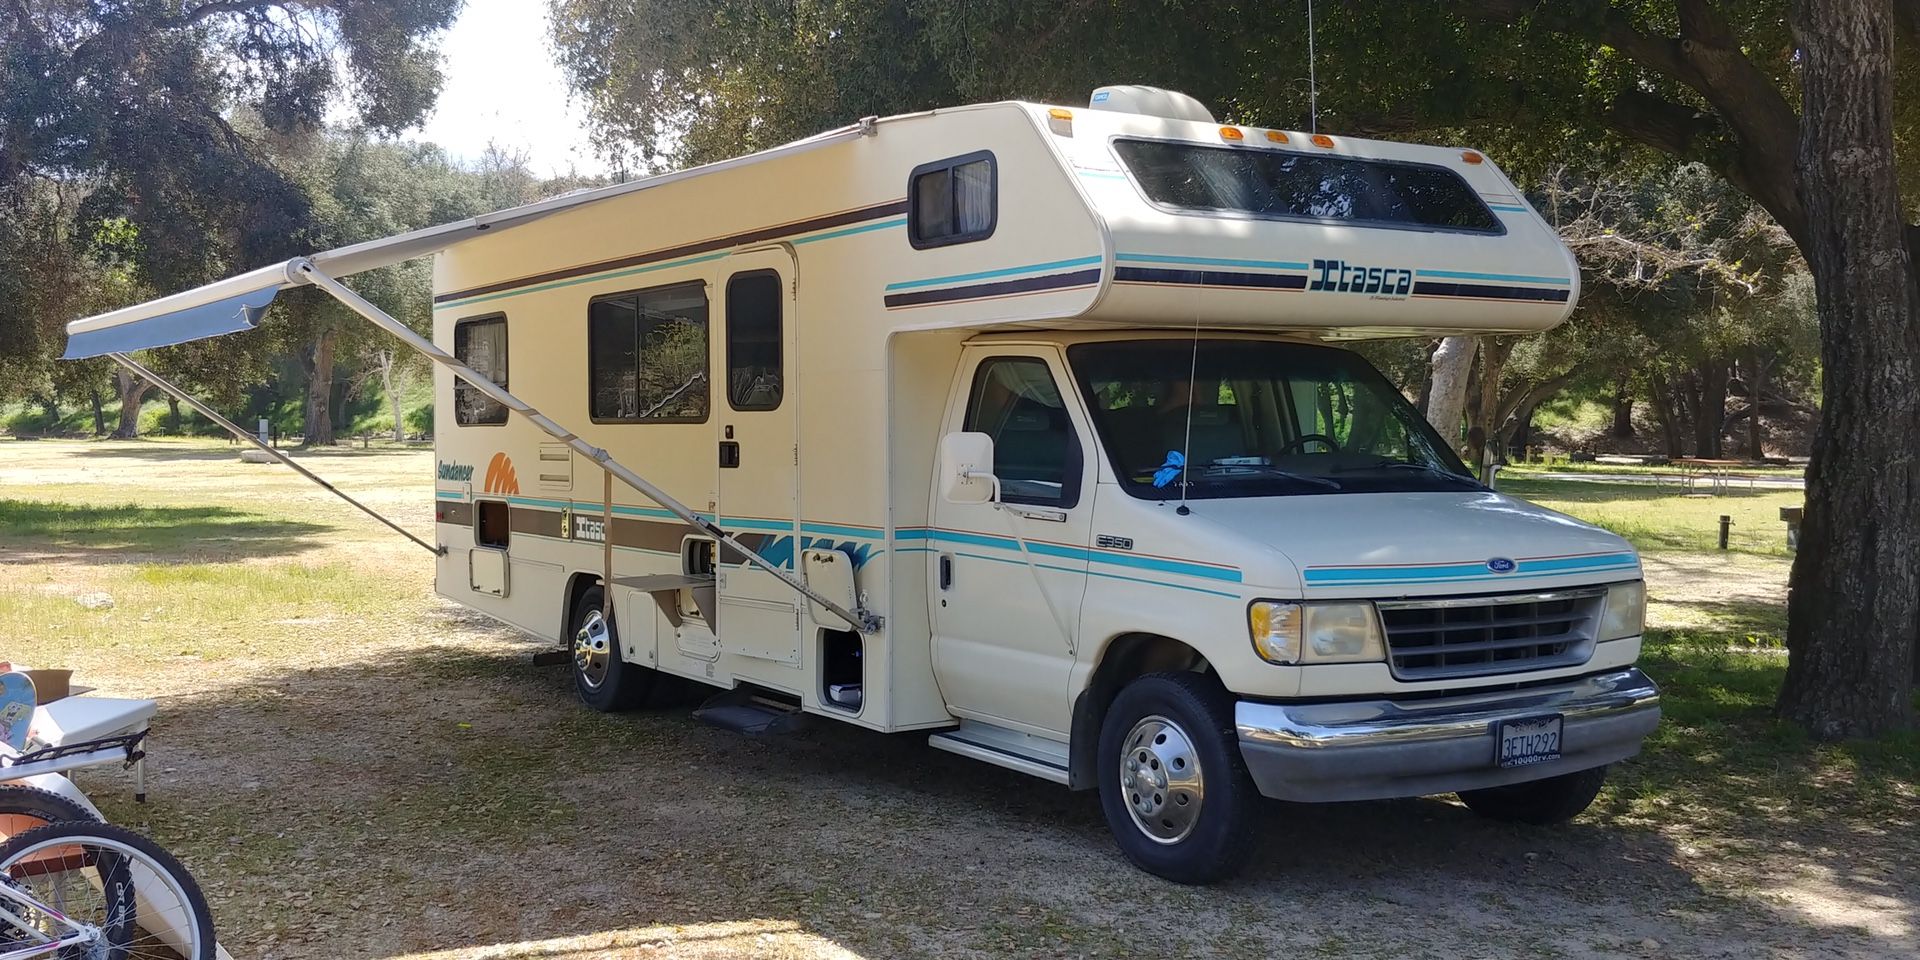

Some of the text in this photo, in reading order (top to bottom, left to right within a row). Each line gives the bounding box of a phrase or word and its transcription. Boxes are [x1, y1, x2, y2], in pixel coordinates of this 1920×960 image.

[576, 516, 606, 541] Itasc
[1096, 535, 1132, 549] E350
[1504, 732, 1557, 758] 3ETH292
